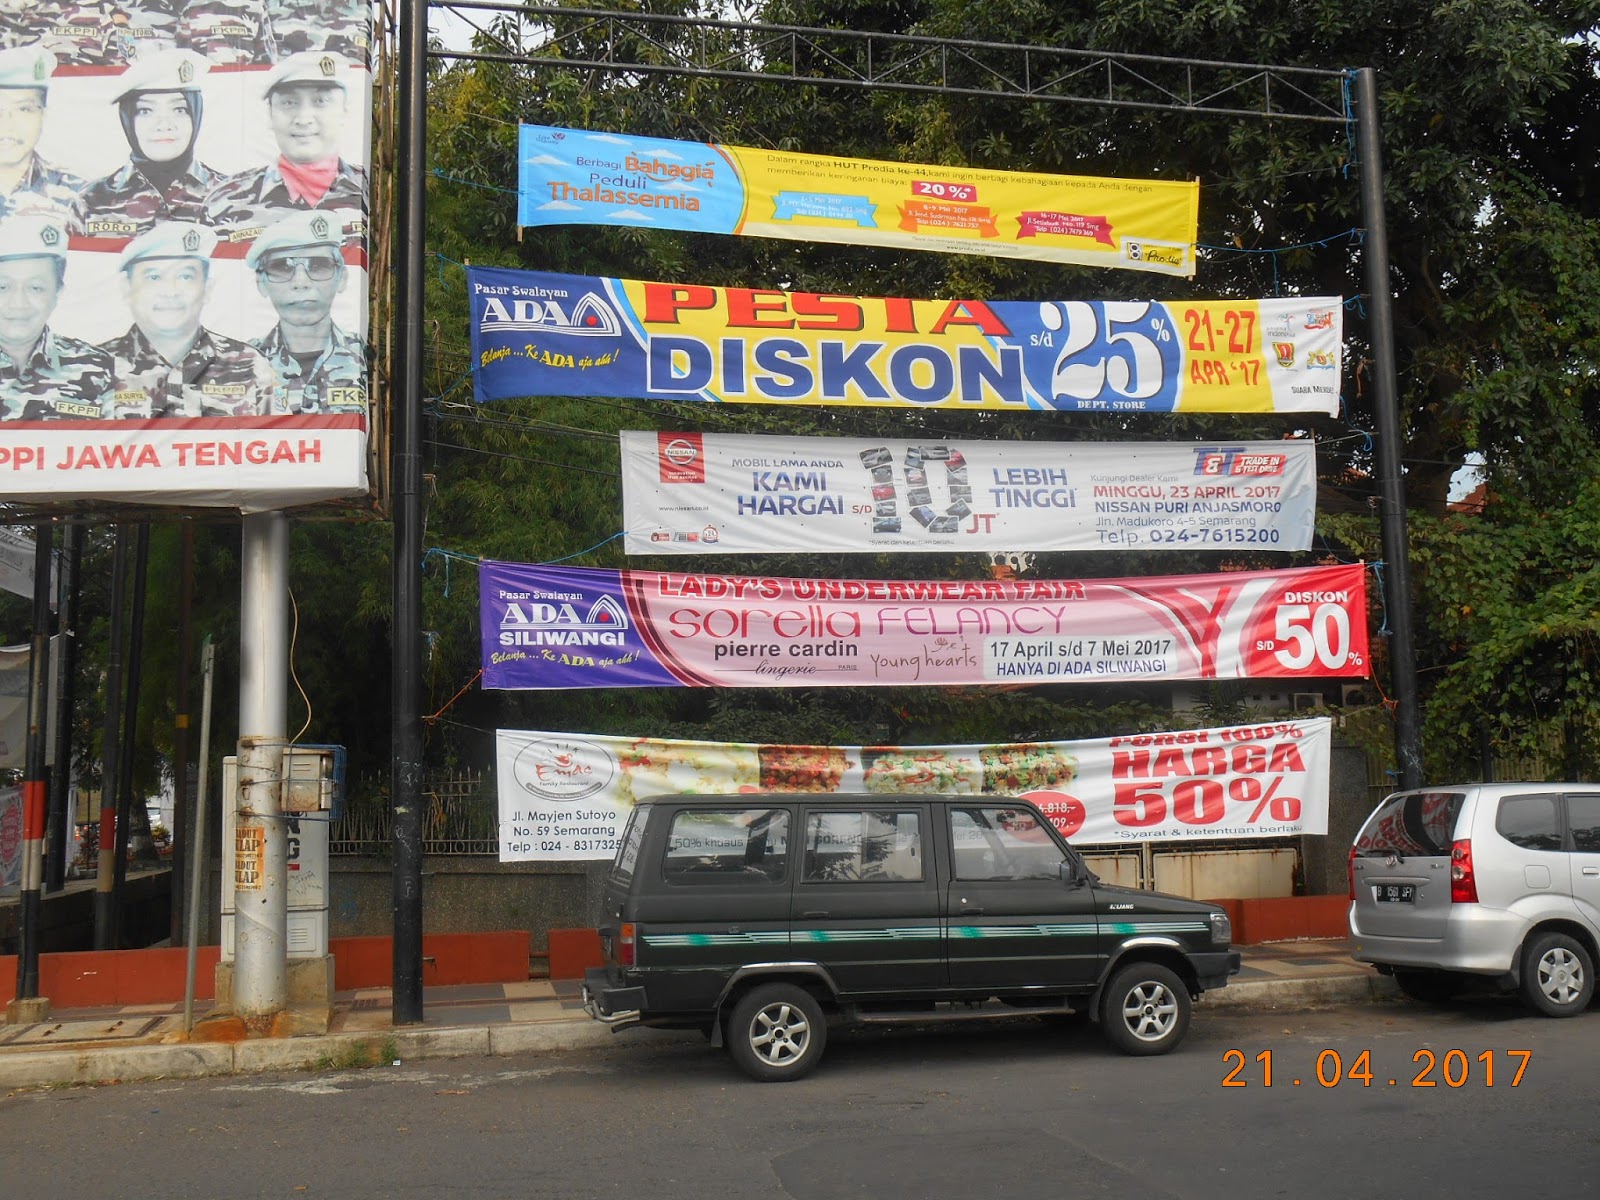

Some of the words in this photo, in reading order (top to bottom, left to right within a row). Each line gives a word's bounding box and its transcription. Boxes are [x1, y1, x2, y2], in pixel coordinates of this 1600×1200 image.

[576, 156, 622, 170] Berbagi
[625, 153, 715, 183] Bahagia
[767, 154, 797, 163] Dalam
[800, 159, 831, 168] rangka
[834, 161, 858, 170] HUT
[862, 164, 895, 173] Prodia
[952, 172, 973, 181] ingin
[976, 173, 1008, 183] berbagi
[1066, 180, 1096, 190] kepada
[1098, 182, 1121, 191] Anda
[1123, 184, 1153, 194] dengan
[767, 166, 826, 178] memberikan
[828, 172, 878, 183] keringanan
[590, 173, 646, 190] Peduli
[920, 182, 945, 197] 20
[547, 181, 700, 212] Thalassemia
[92, 222, 132, 232] RORO
[474, 283, 510, 295] Pasar
[512, 286, 568, 300] Swalayan
[481, 297, 571, 326] ADA
[642, 283, 1014, 338] PESTA
[1030, 331, 1054, 348] s/d
[1184, 309, 1256, 354] 21-27
[480, 346, 512, 368] Belanja
[539, 350, 575, 368] ADA
[578, 357, 594, 372] aja
[1039, 301, 1164, 400] 25
[646, 332, 1028, 407] DISKON
[1190, 360, 1228, 386] APR
[1077, 400, 1110, 409] DEPT.
[1112, 401, 1146, 410] STORE
[56, 444, 162, 470] JAWA
[172, 439, 322, 468] TENGAH
[732, 458, 771, 468] MOBIL
[773, 459, 809, 468] LAMA
[810, 460, 844, 468] ANDA
[1240, 456, 1268, 466] TRADE
[1270, 456, 1280, 466] IN
[753, 472, 827, 492] KAMI
[992, 468, 1068, 486] LEBIH
[1090, 474, 1128, 484] Kunjungi
[1130, 474, 1156, 482] Dealer
[1157, 474, 1178, 482] Kami
[988, 488, 1076, 508] TINGGI
[1093, 486, 1166, 501] MINGGU,
[1170, 486, 1190, 498] 23
[1194, 486, 1240, 498] APRIL
[1244, 486, 1281, 498] 2017
[658, 504, 709, 512] www.nissan.co.id
[738, 494, 844, 516] HARGAI
[852, 504, 873, 514] S/D
[1095, 502, 1150, 513] NISSAN
[1154, 502, 1188, 514] PURI
[1192, 501, 1282, 513] ANJASMORO
[1116, 516, 1174, 526] Madukoro
[1176, 516, 1196, 526] 4-5
[1199, 516, 1256, 528] Semarang
[1096, 528, 1144, 547] Telp.
[1150, 528, 1280, 544] 024-7615200
[500, 590, 531, 600] Pasar
[533, 590, 583, 602] Swalayan
[658, 575, 782, 600] LADY'S
[791, 579, 1010, 601] UNDERWEAR
[1013, 581, 1088, 601] FAIR
[1285, 591, 1348, 604] DISKON
[501, 602, 582, 624] ADA
[668, 604, 861, 638] sorella
[877, 606, 1066, 636] FELANCY
[500, 631, 625, 646] SILIWANGI
[1256, 640, 1275, 652] S/D
[1274, 603, 1350, 670] 50
[1348, 652, 1363, 666] %
[714, 641, 781, 661] pierre
[788, 640, 858, 658] cardin
[990, 642, 1009, 658] 17
[1013, 641, 1056, 659] April
[1058, 640, 1083, 657] s/d
[1088, 640, 1097, 657] 7
[1102, 639, 1130, 656] Mei
[1134, 639, 1171, 656] 2017
[490, 652, 527, 665] Belanja
[557, 653, 595, 667] ADA
[598, 658, 614, 669] aja
[755, 659, 818, 680] lingerie
[997, 662, 1044, 676] HANYA
[1048, 662, 1061, 675] DI
[1064, 661, 1093, 675] ADA
[1096, 659, 1167, 674] SILIWANGI
[1112, 742, 1306, 779] HARGA
[1113, 776, 1302, 827] 50%
[512, 811, 524, 822] Jl.
[528, 811, 573, 824] Mayjen
[576, 810, 616, 823] Sutoyo
[513, 826, 534, 837] No.
[537, 826, 551, 836] 59
[554, 825, 616, 838] Semarang
[1171, 828, 1181, 836] &
[1186, 826, 1256, 836] ketentuan
[1259, 824, 1303, 834] berlaku
[508, 842, 532, 854] Telp
[540, 840, 562, 852] 024
[674, 838, 702, 849] 50%
[704, 838, 744, 848] khusus
